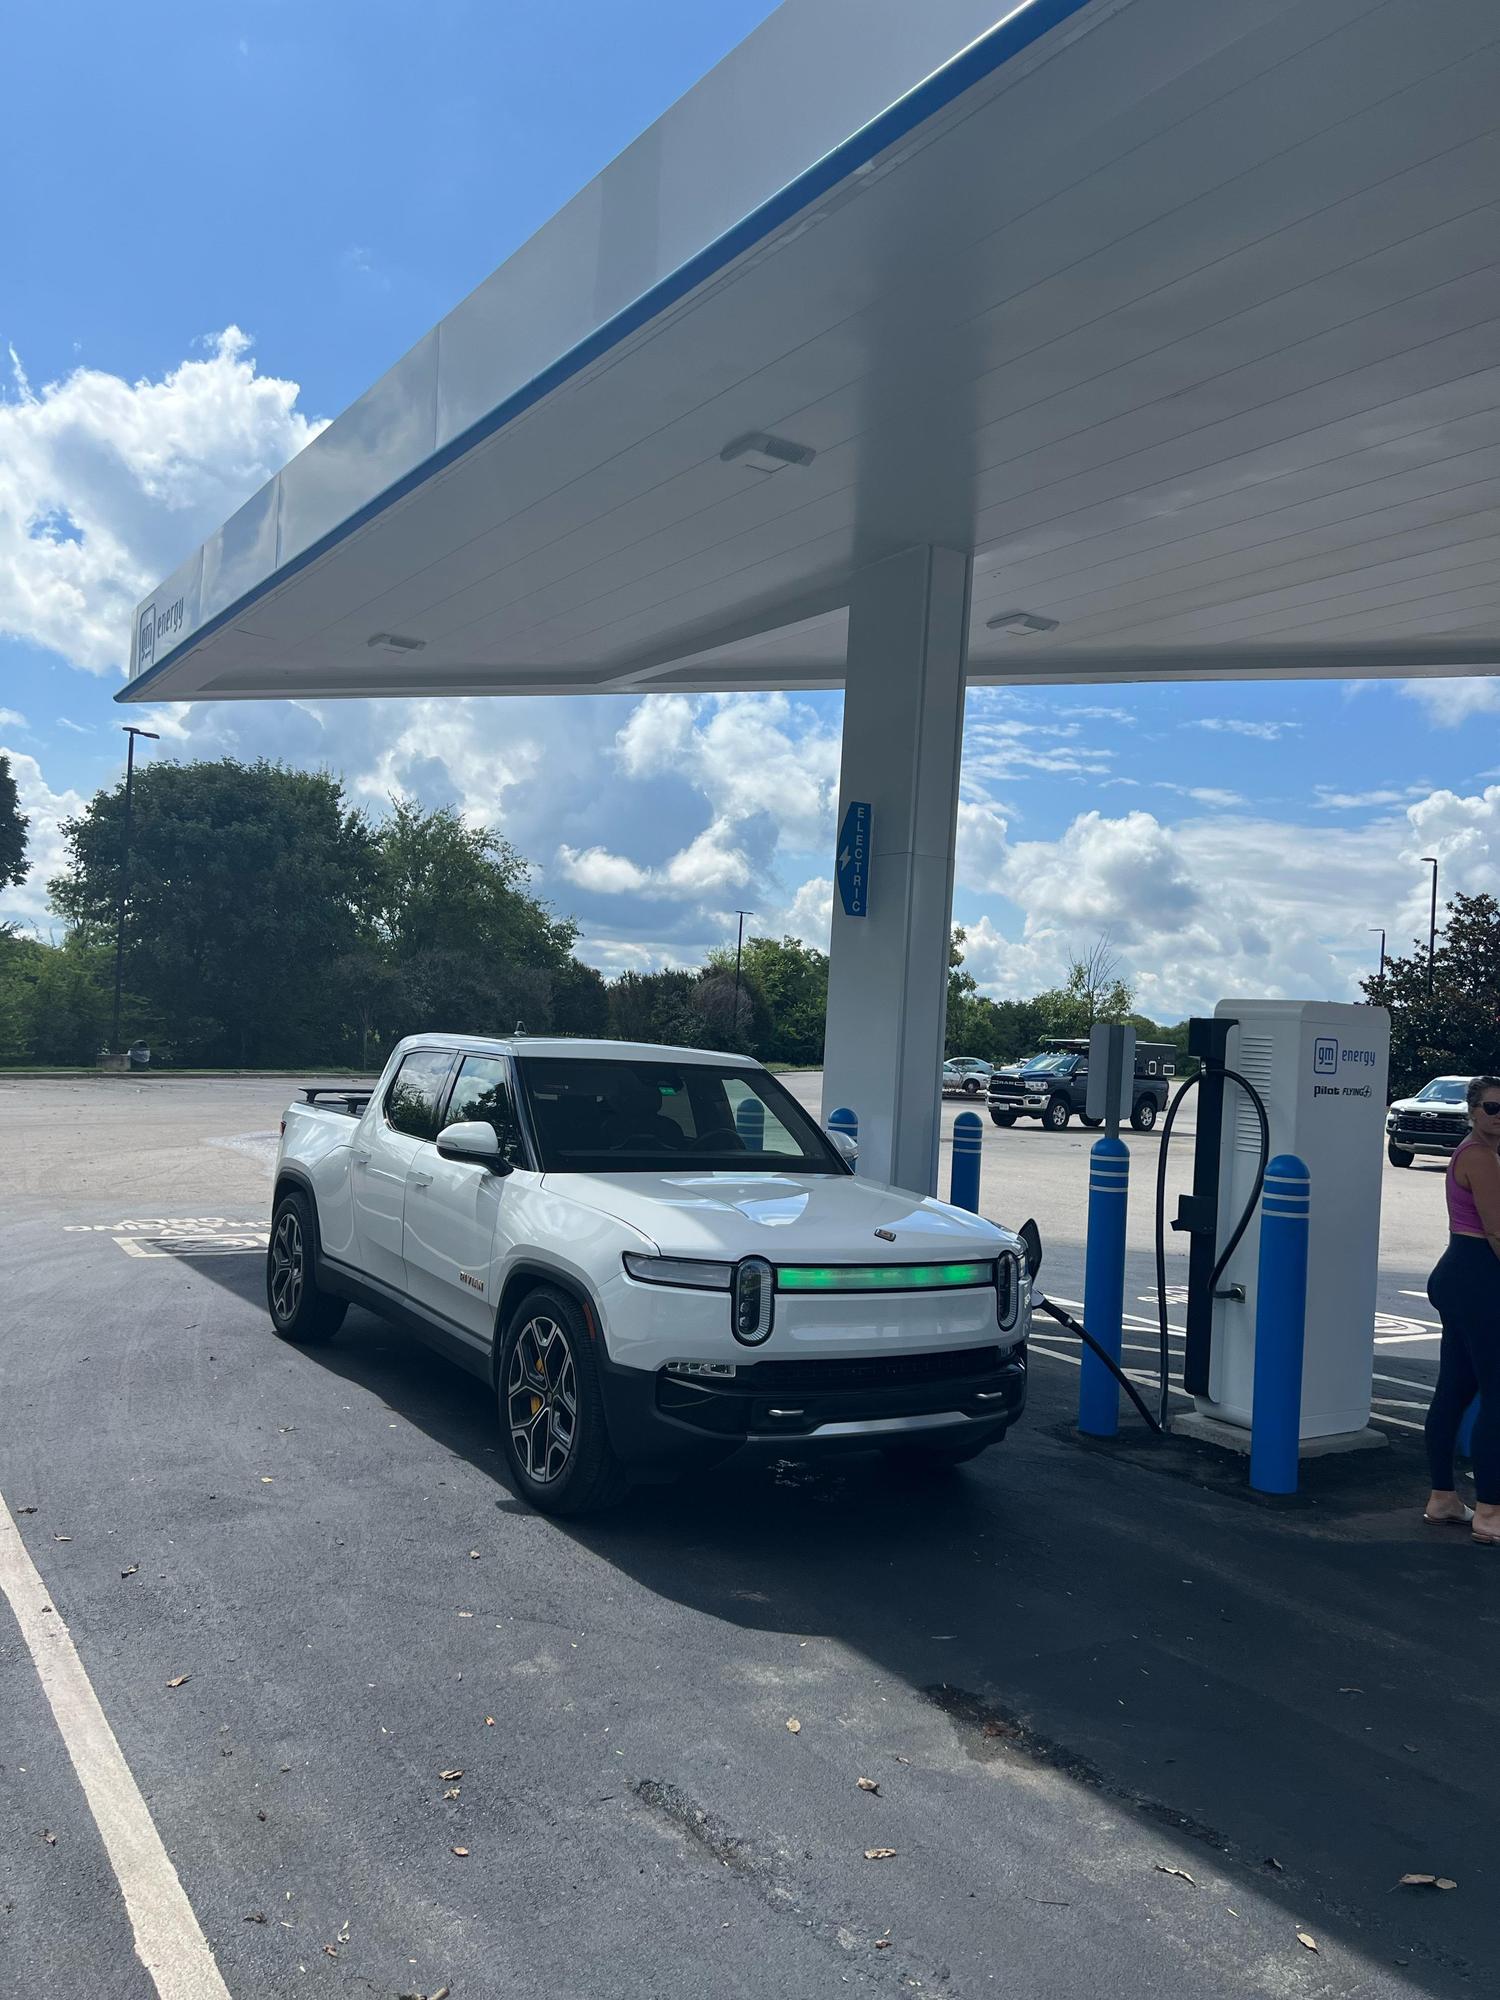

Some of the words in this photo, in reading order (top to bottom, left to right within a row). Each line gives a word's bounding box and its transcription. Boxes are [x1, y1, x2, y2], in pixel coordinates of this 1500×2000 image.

[141, 622, 153, 662] gm
[157, 596, 184, 638] energy
[851, 807, 865, 913] ELECTRIC
[1318, 1046, 1334, 1065] gm
[1341, 1049, 1376, 1067] energy
[459, 1270, 484, 1293] RIVIAN
